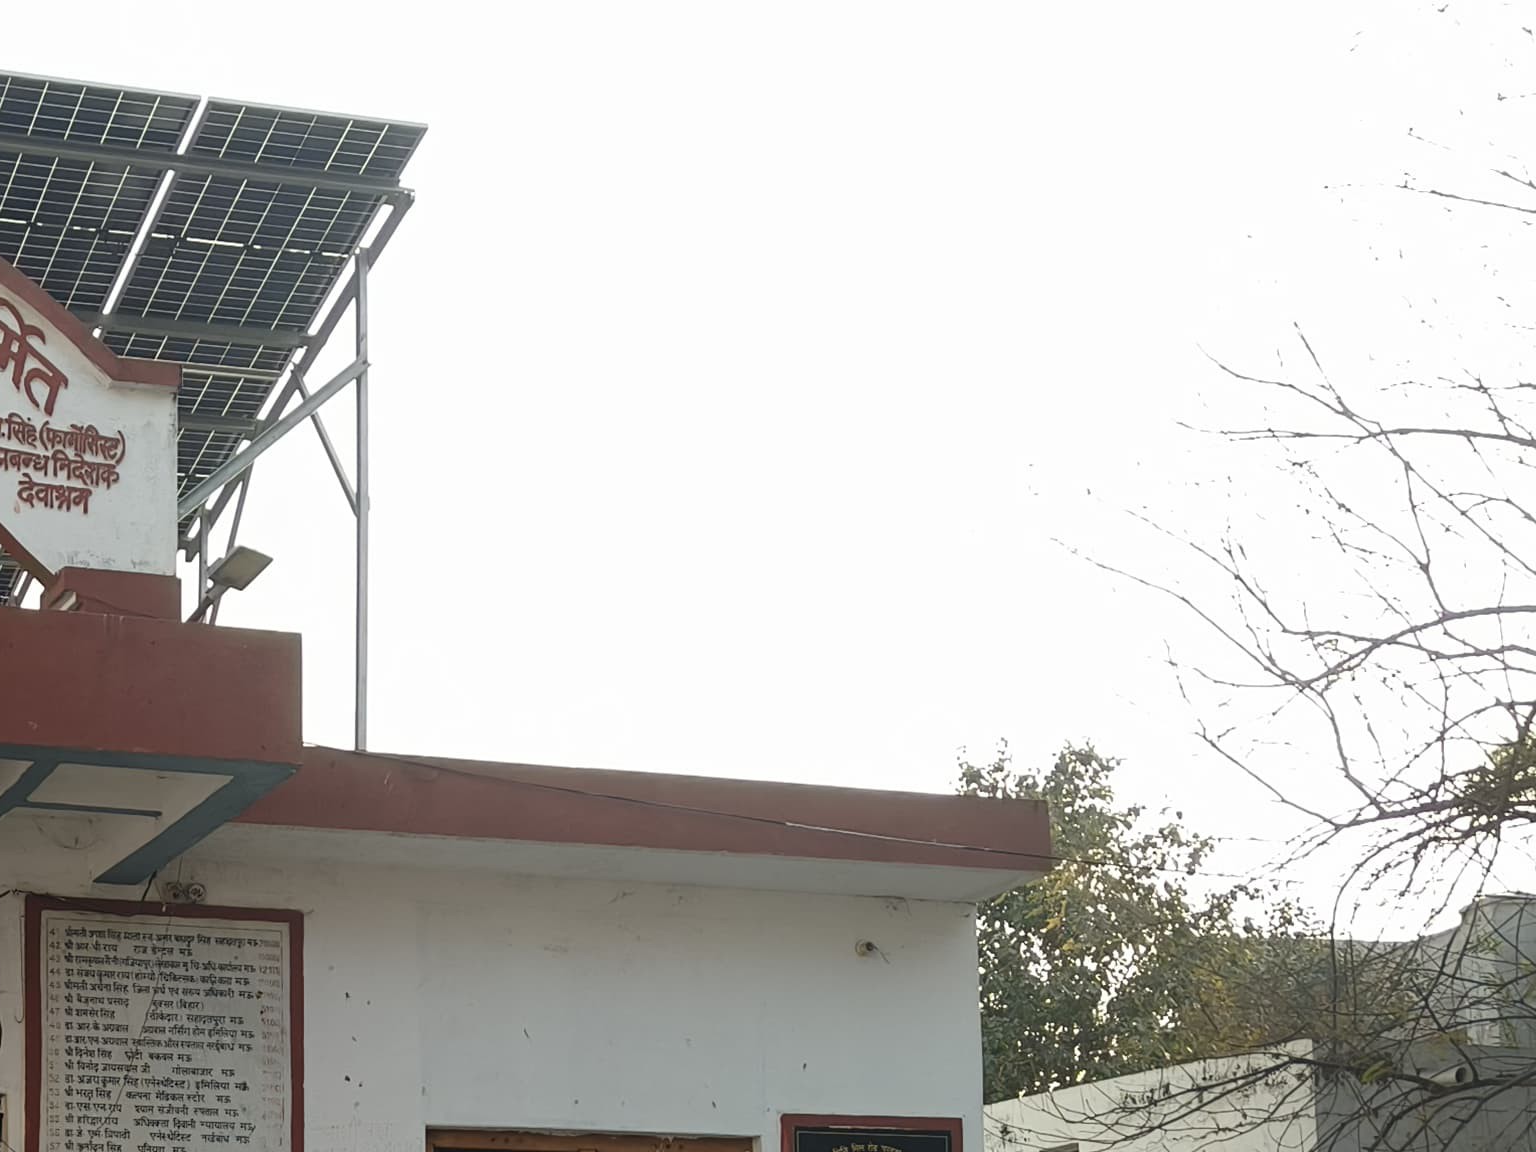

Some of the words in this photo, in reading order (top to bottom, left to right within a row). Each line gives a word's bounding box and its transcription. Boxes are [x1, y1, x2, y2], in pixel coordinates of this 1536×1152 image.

[50, 449, 120, 491] निदेशक
[17, 473, 92, 514] देवाश्रम
[221, 1068, 235, 1077] मऊ
[216, 1095, 231, 1104] मऊ
